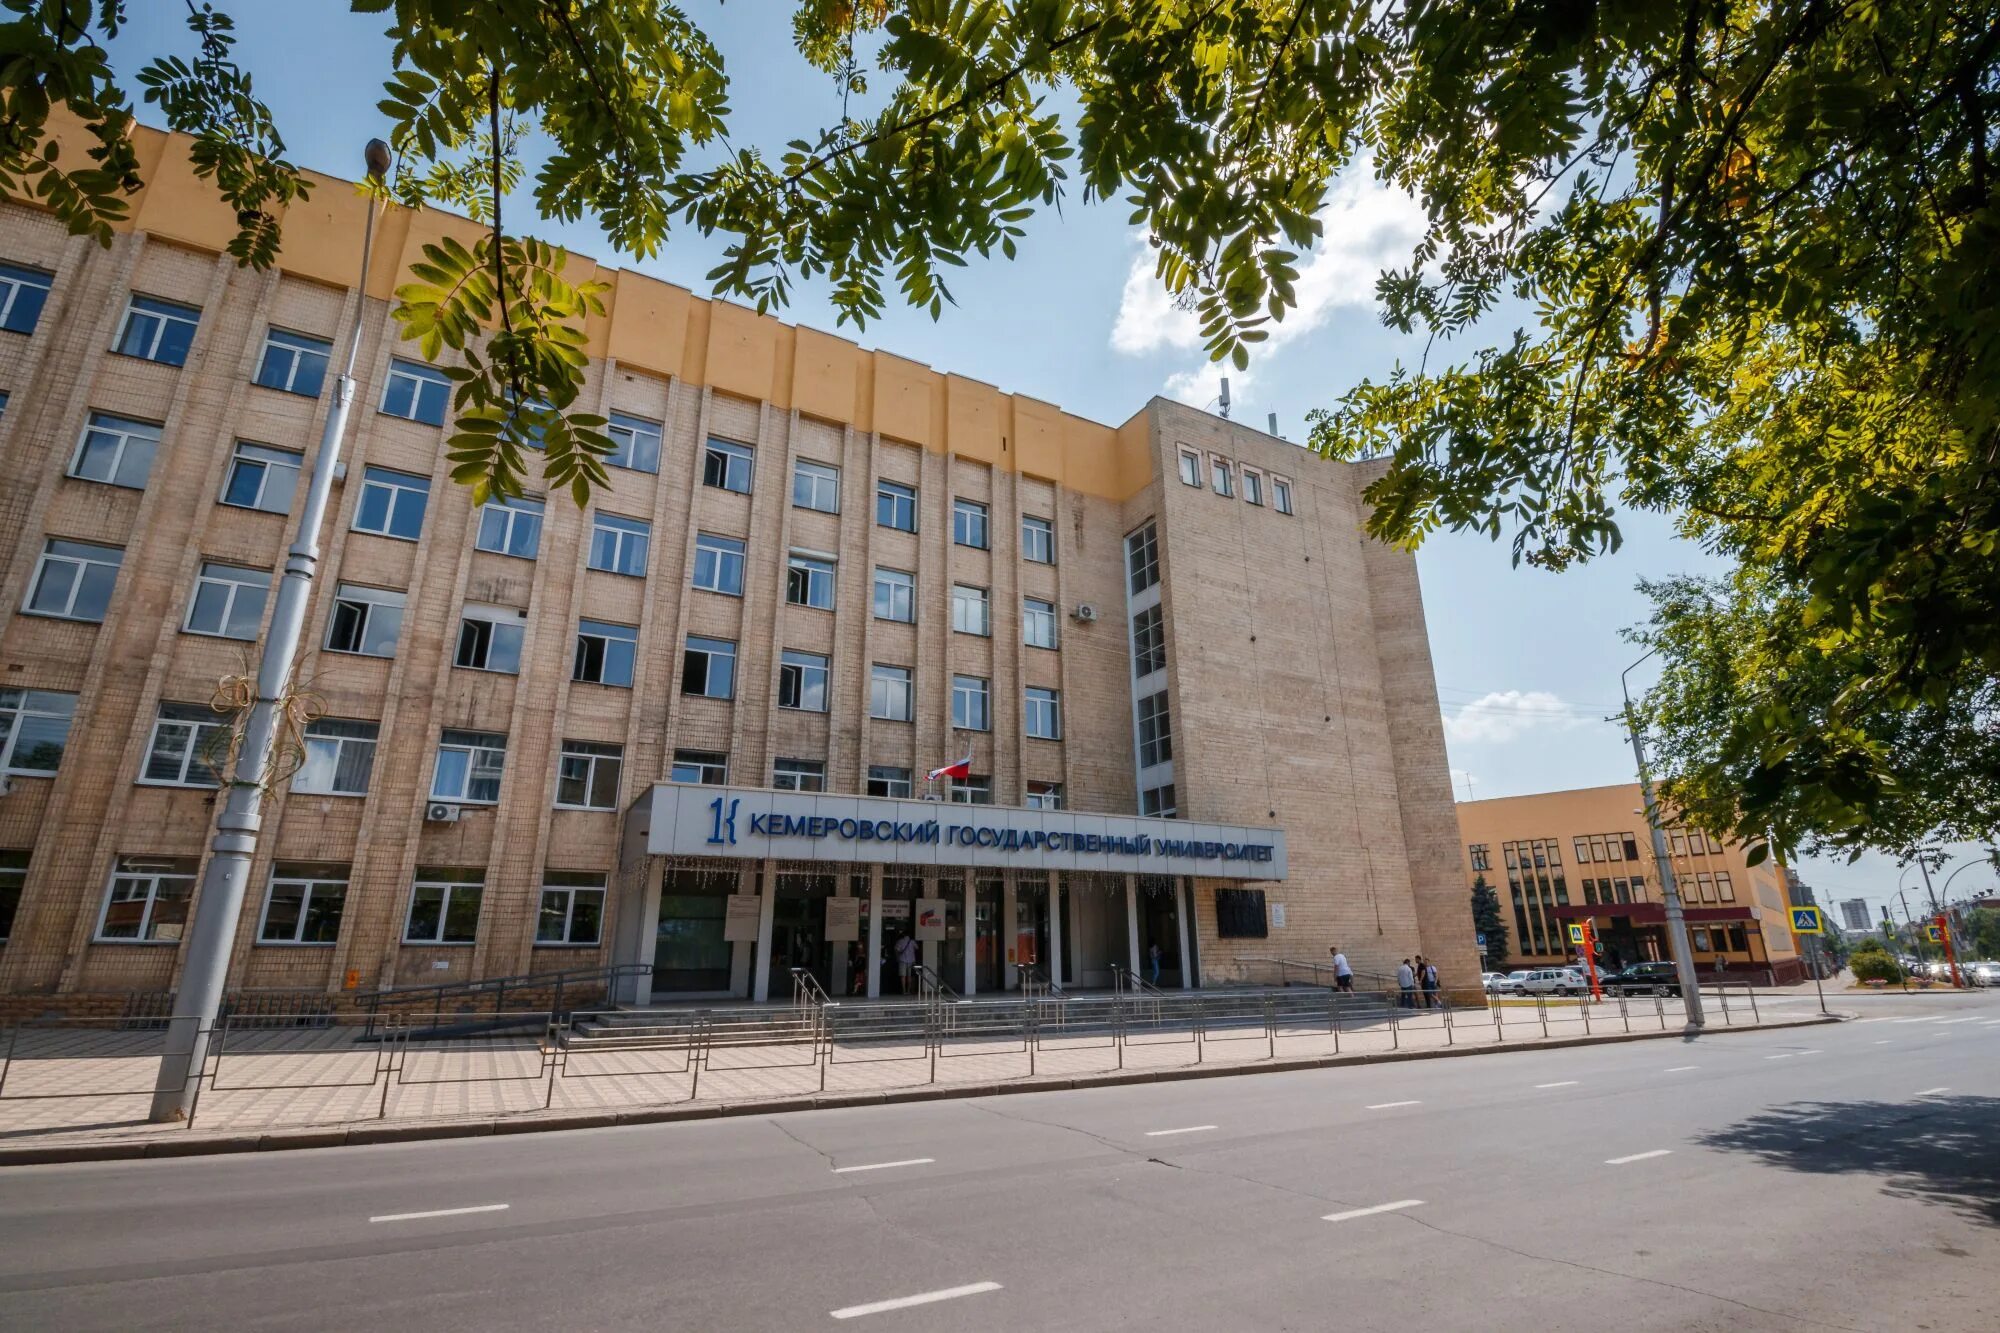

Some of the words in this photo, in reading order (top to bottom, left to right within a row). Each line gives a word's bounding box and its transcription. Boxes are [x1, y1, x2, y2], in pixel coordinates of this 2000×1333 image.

[750, 813, 940, 844] КЕМЕРОВСКИЙ
[949, 825, 1151, 855] ГОСУДАРСТВЕННЫЙ
[1157, 838, 1274, 862] УНИВЕРСИТЕТ
